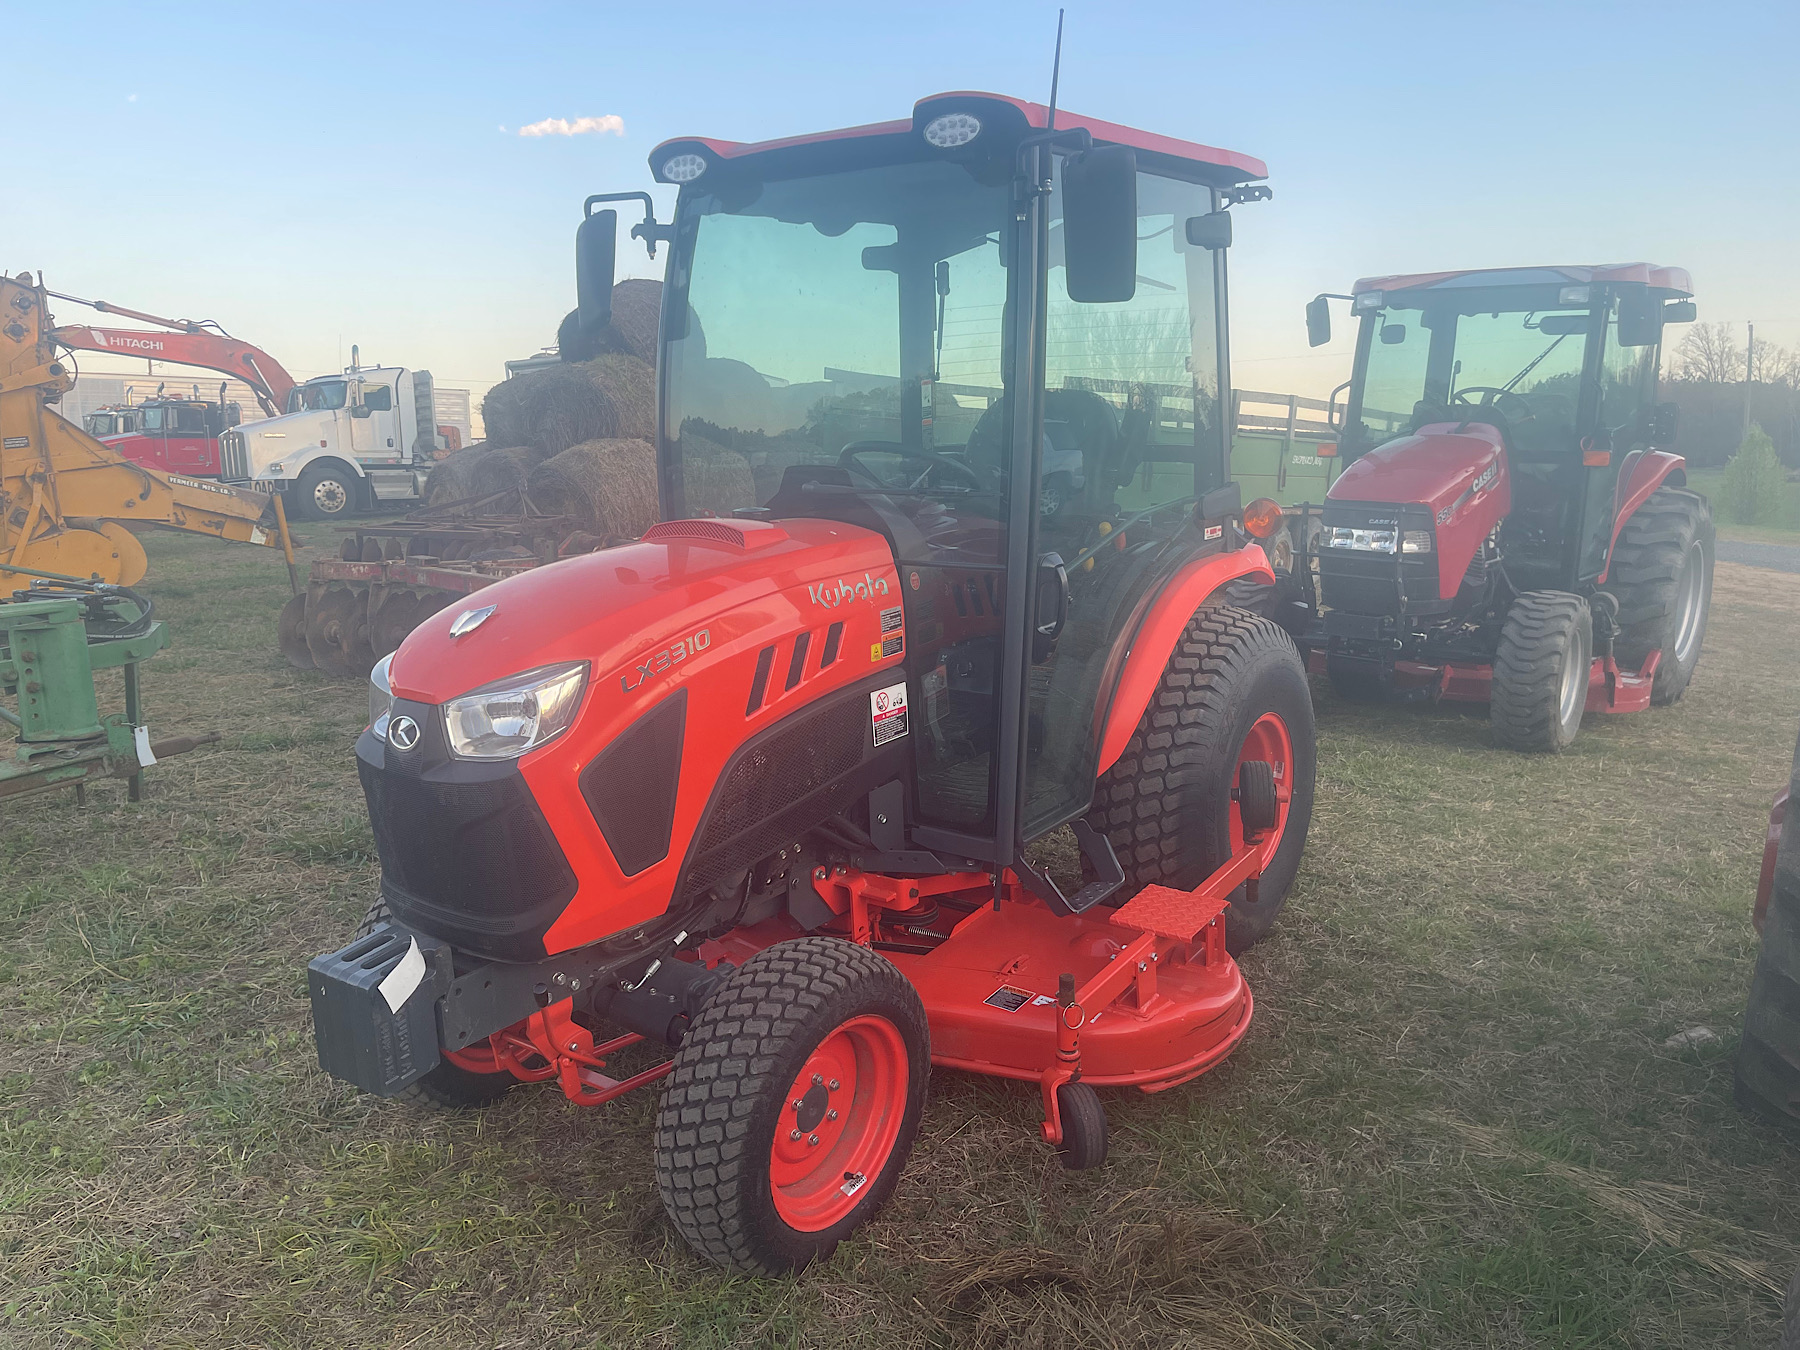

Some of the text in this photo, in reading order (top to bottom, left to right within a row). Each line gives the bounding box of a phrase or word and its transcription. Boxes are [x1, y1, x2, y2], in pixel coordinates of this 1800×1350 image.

[109, 336, 164, 351] HITACHI
[169, 476, 199, 488] VERMEER
[1472, 466, 1492, 492] CASE
[808, 572, 889, 609] Kubota
[620, 629, 711, 694] LX3310
